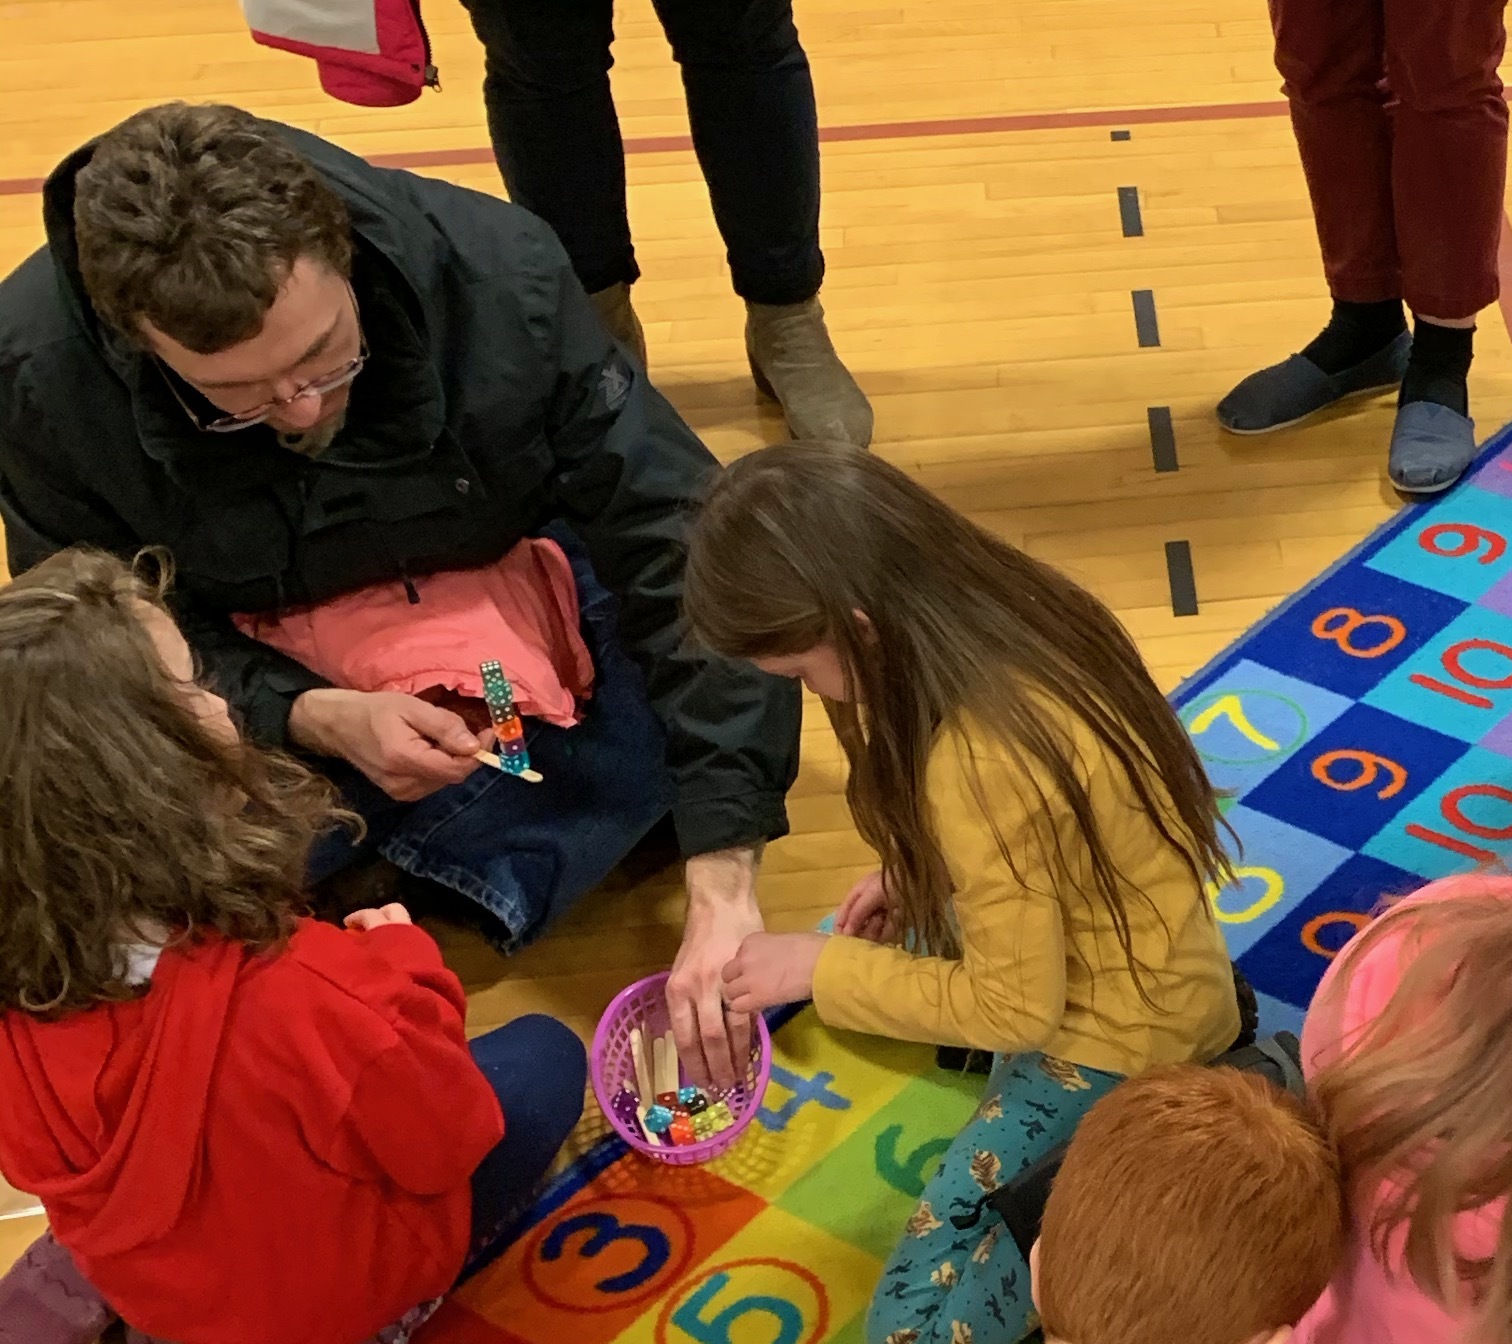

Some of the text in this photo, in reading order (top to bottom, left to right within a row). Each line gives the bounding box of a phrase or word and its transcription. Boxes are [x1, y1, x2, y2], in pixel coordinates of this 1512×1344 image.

[1311, 607, 1406, 659] 8
[1189, 695, 1280, 751] 7
[541, 1214, 672, 1294] 3
